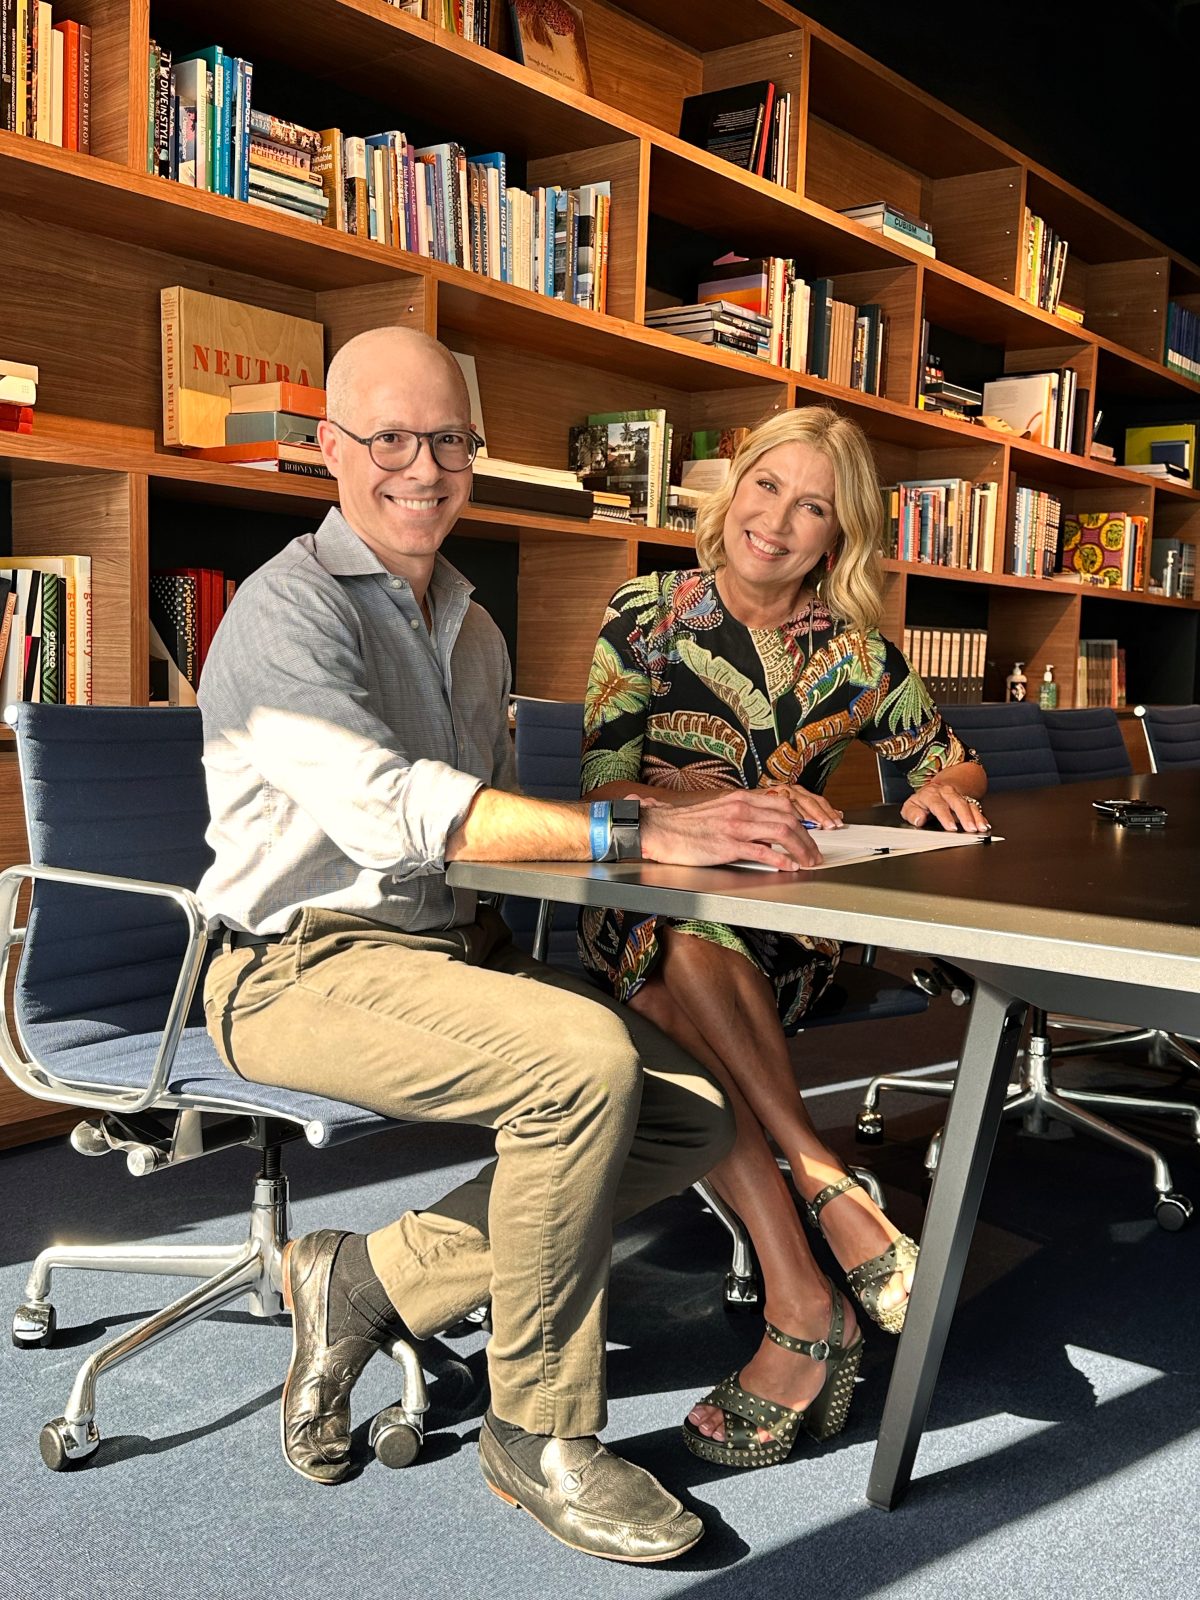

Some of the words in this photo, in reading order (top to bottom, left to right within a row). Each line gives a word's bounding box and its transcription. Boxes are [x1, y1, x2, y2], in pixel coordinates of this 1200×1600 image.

[160, 79, 168, 104] DIVE
[160, 116, 168, 147] STYLE
[250, 138, 290, 157] AREFOOT
[251, 147, 290, 166] RCHITECT
[894, 217, 917, 234] CUBISM
[192, 344, 311, 387] NEUTRA
[284, 462, 312, 474] RODNEY
[67, 592, 76, 658] geometry
[83, 592, 92, 658] geometry
[49, 631, 57, 668] orinoco
